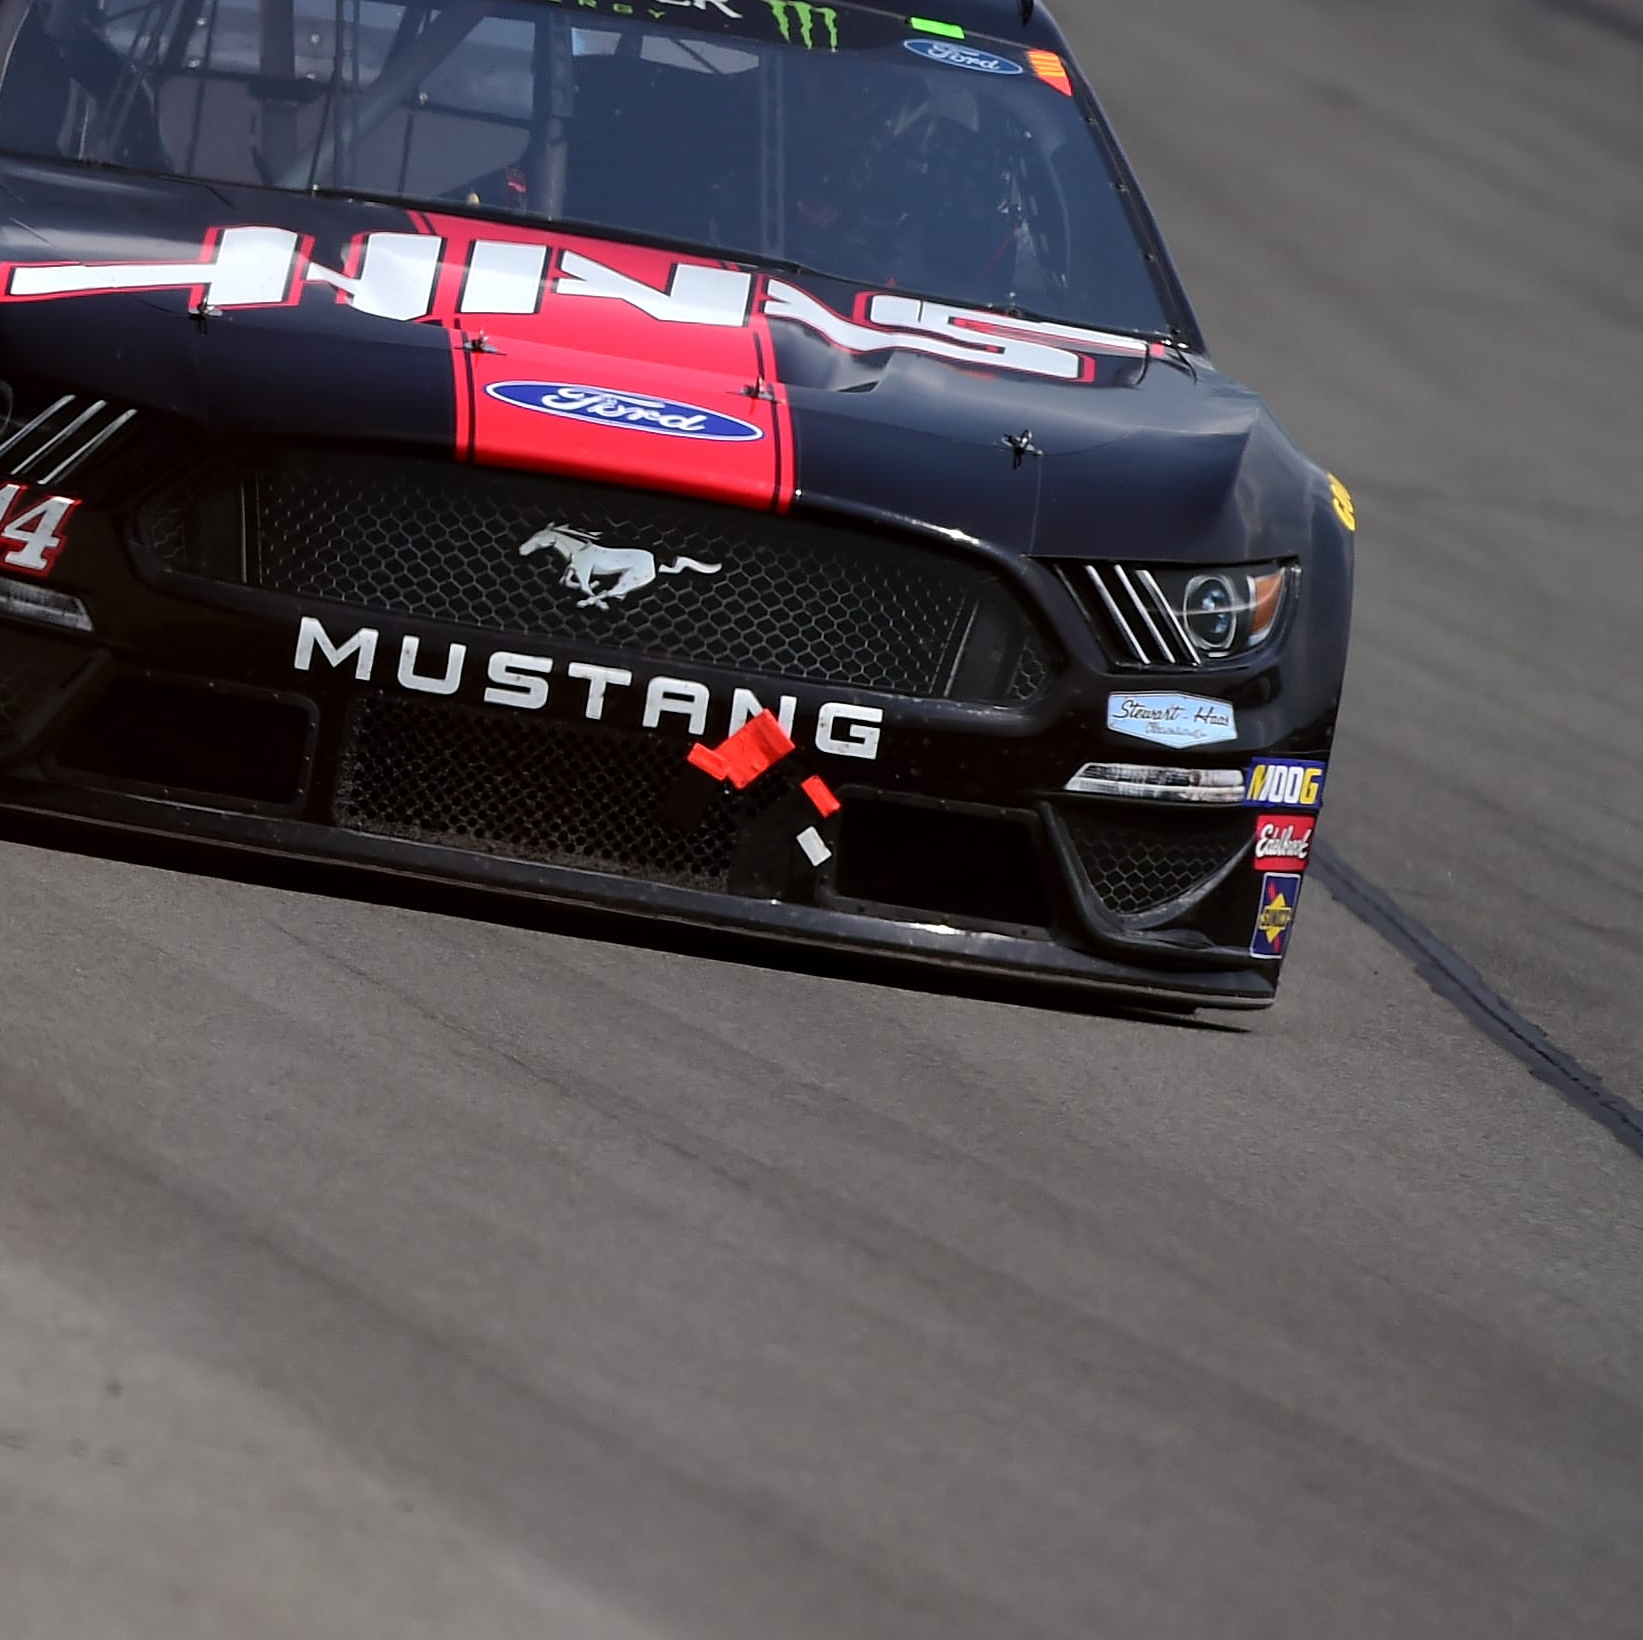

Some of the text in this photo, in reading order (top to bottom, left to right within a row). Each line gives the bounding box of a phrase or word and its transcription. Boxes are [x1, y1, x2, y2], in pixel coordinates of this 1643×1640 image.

[924, 42, 1004, 71] Ford
[537, 386, 713, 432] Ford
[293, 615, 884, 761] MUSTANG
[1247, 764, 1323, 805] MOOG
